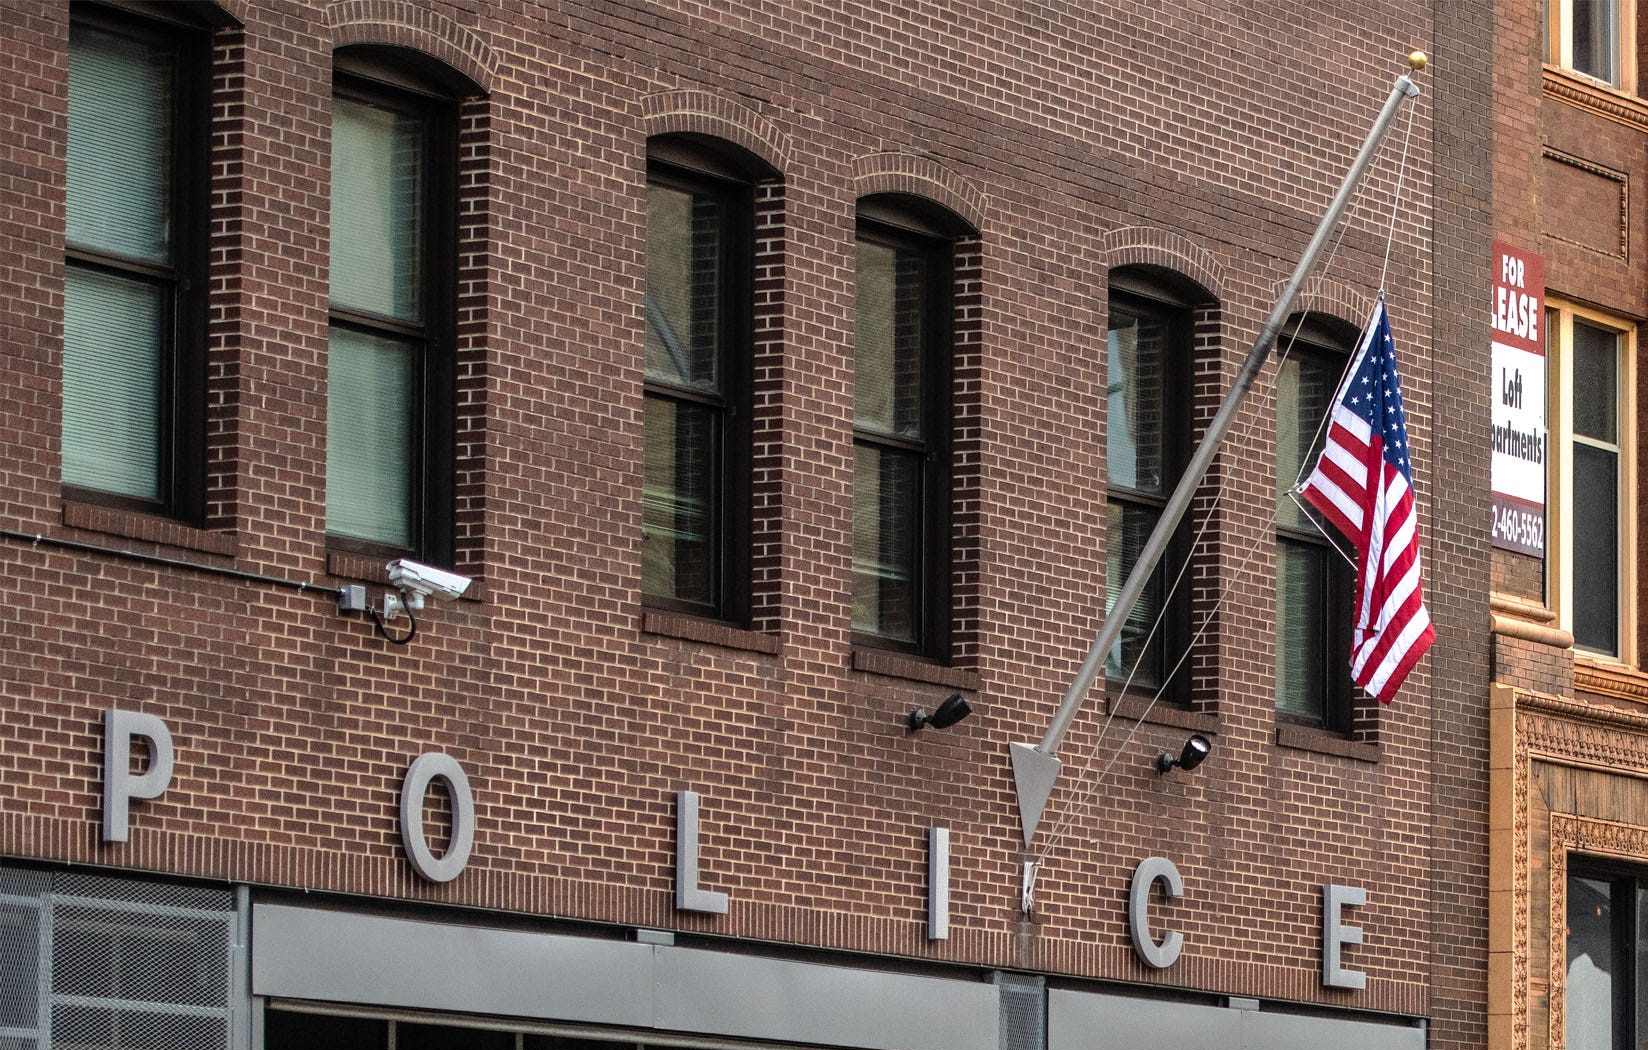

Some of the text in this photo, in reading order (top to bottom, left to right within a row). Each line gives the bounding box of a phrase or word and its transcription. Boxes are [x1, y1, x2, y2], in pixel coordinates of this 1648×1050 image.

[1502, 254, 1525, 289] FOR
[1491, 285, 1538, 342] LEASE
[1502, 367, 1523, 410] Loft
[1491, 420, 1542, 465] partments
[1491, 505, 1543, 550] 2-460-5562
[102, 709, 1367, 990] POLICE
